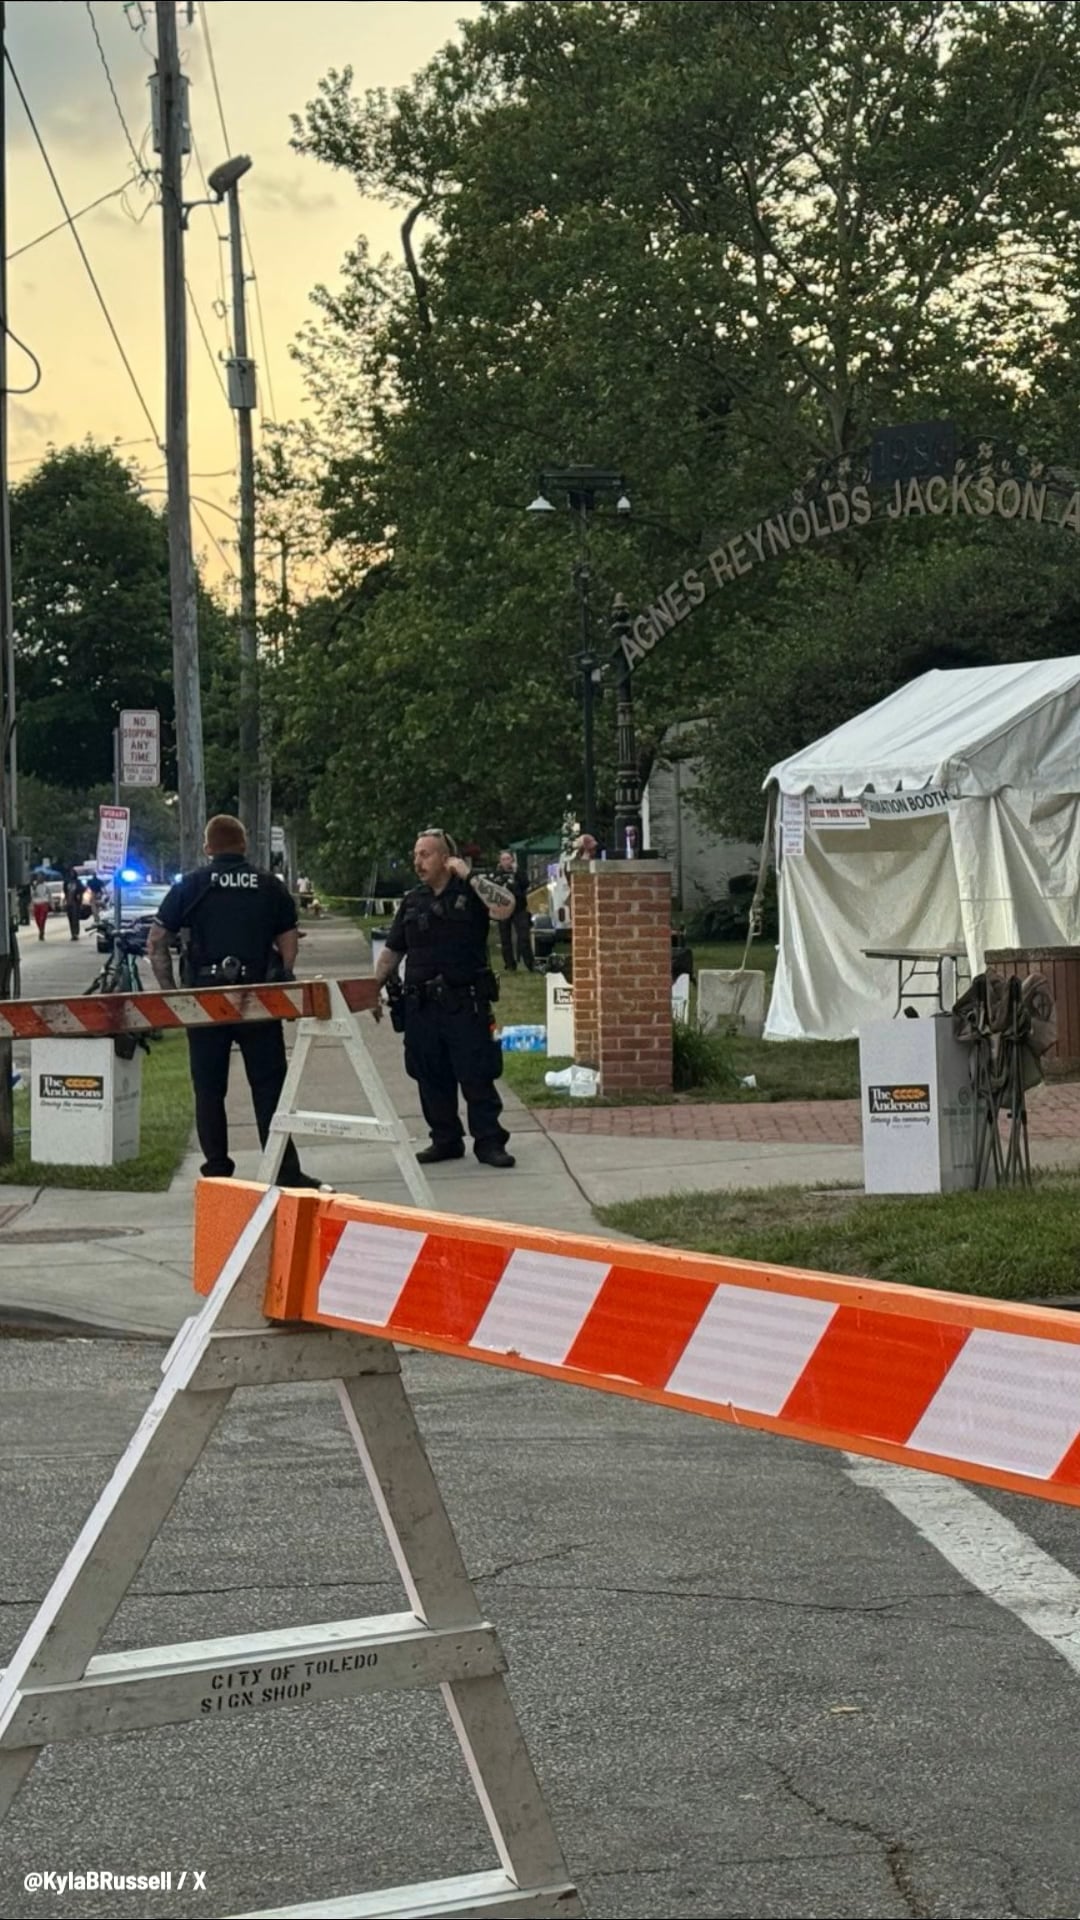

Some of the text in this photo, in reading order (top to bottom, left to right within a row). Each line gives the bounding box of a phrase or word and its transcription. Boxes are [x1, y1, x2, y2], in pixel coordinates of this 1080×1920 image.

[620, 568, 706, 670] AGNES
[708, 486, 872, 588] REYNOLDS
[887, 475, 1047, 523] JACKSON
[132, 716, 146, 727] NO
[131, 741, 149, 750] ANY
[131, 751, 149, 761] TIME
[907, 790, 950, 811] BOOTH
[211, 872, 259, 888] POLICE
[43, 1076, 63, 1088] The
[43, 1087, 102, 1098] Andersons
[871, 1087, 892, 1100] The
[871, 1099, 929, 1112] Andersons
[211, 1653, 378, 1690] CITY OF TOLEDO
[200, 1682, 312, 1714] SIGN SHOP
